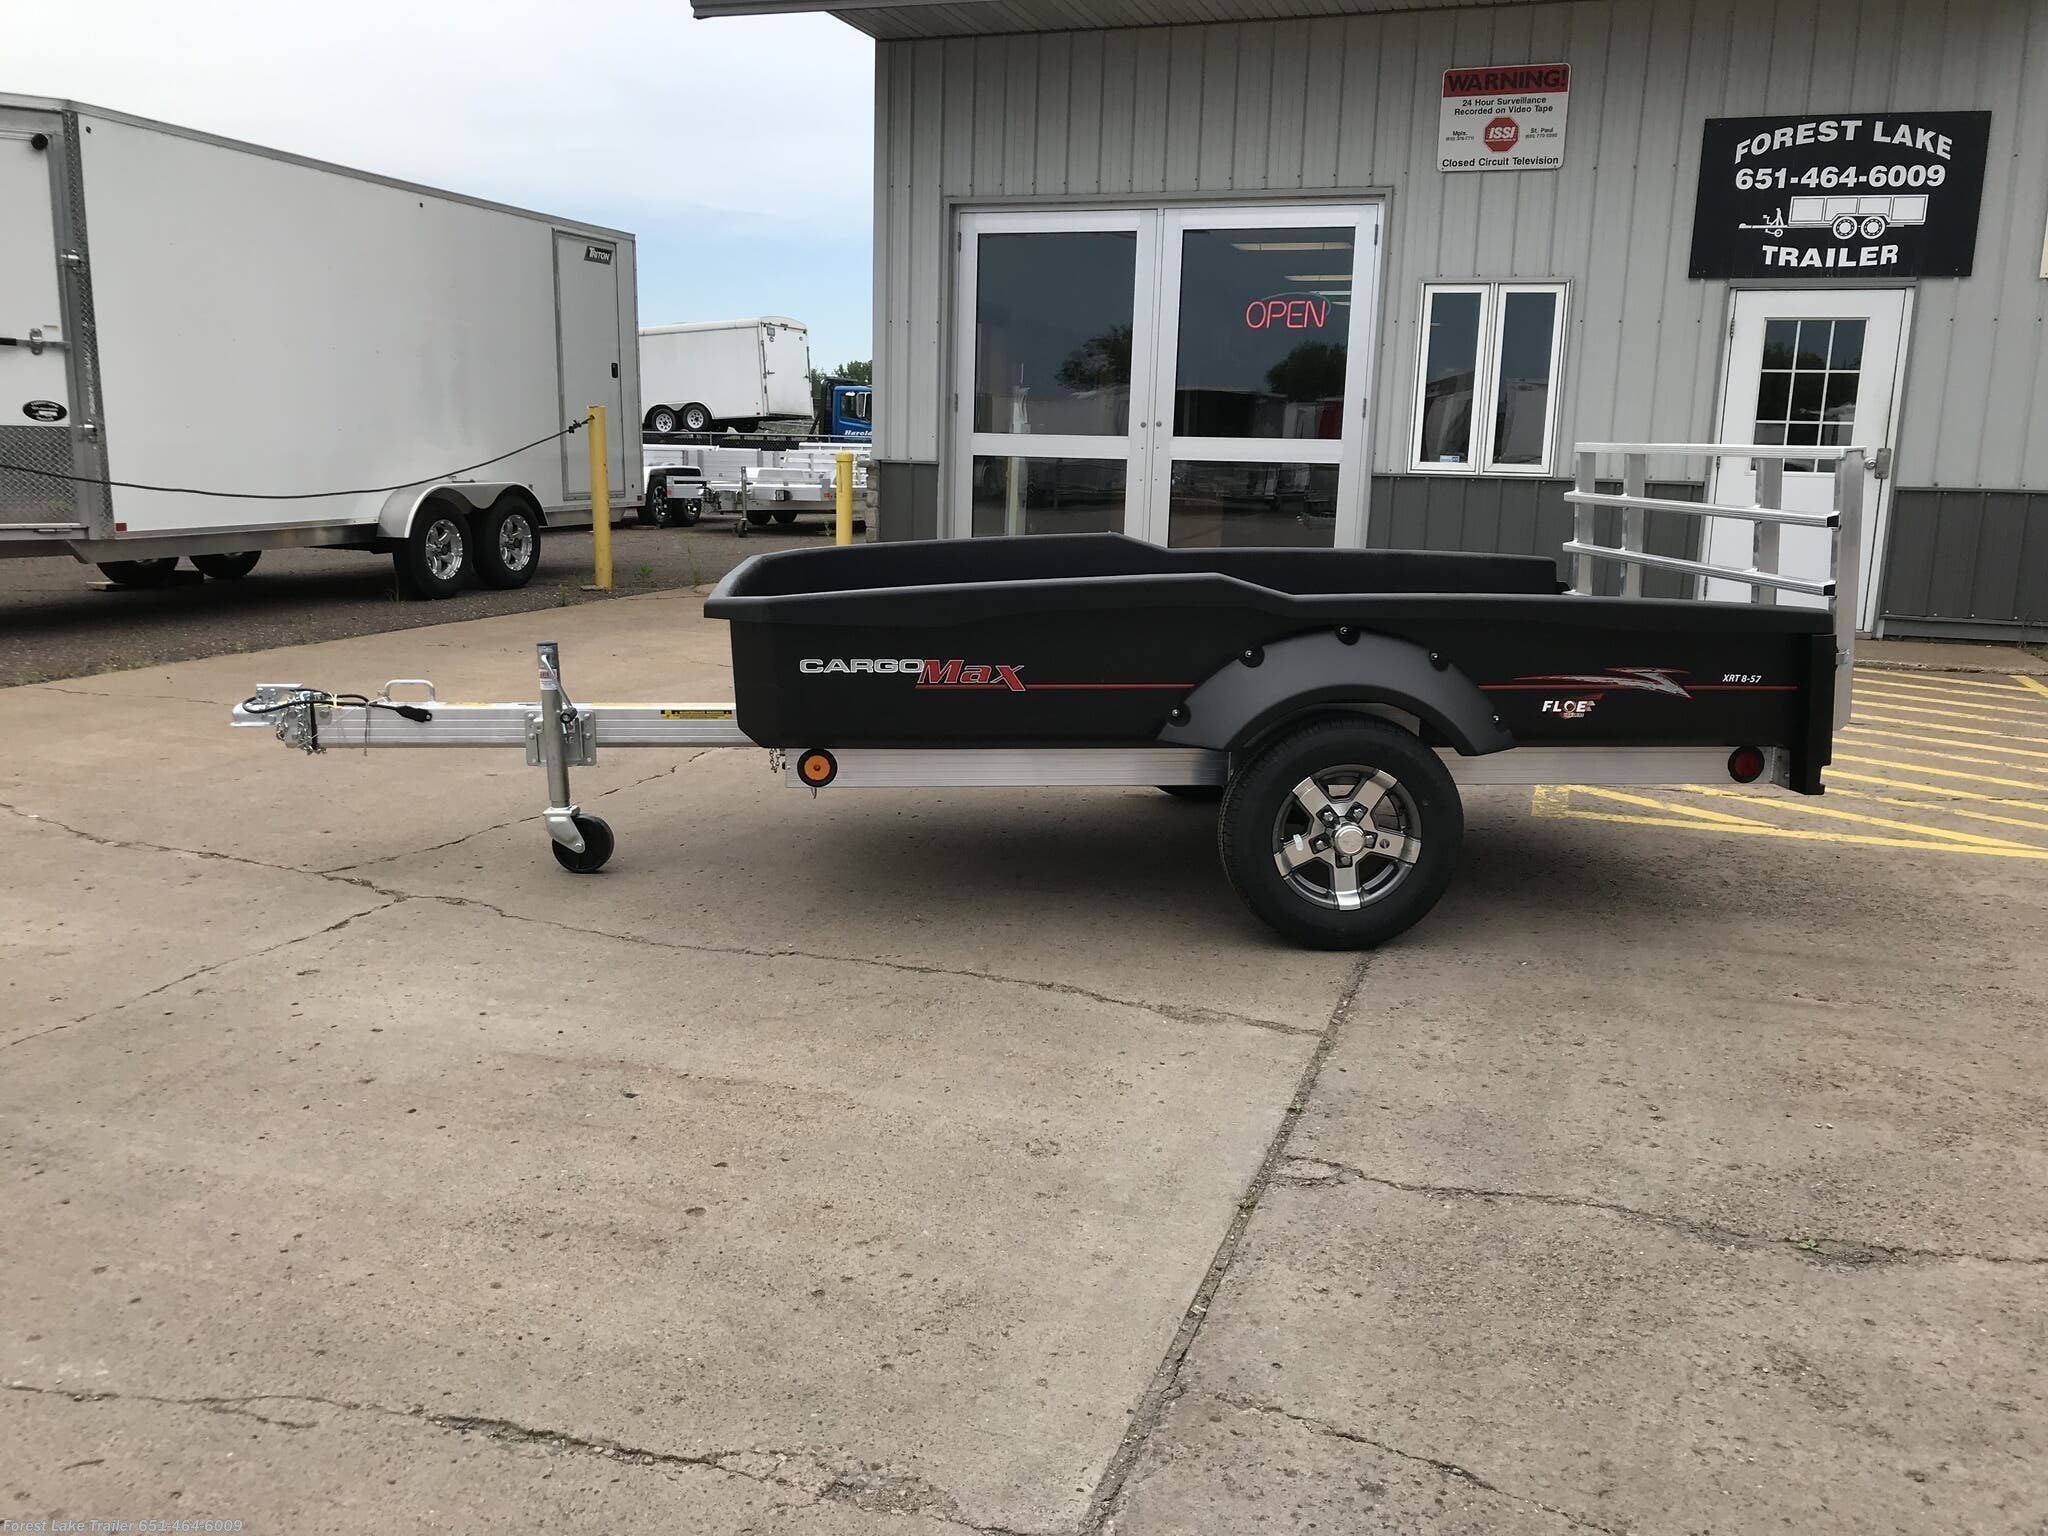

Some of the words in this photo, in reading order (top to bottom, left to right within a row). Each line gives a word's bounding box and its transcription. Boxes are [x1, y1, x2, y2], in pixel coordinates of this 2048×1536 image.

[1448, 70, 1566, 91] WARNING!
[1497, 97, 1547, 105] Surveillance
[1454, 107, 1493, 115] Recorded
[1534, 105, 1553, 113] Tape
[1489, 126, 1516, 139] ISSI
[1734, 119, 1863, 164] FOREST
[1872, 121, 1953, 160] LAKE
[1442, 158, 1475, 167] Closed
[1478, 157, 1509, 166] Circuit
[1512, 156, 1559, 165] Television
[1735, 165, 1946, 190] 651-464-6009
[589, 247, 611, 261] TRITON
[1762, 244, 1899, 268] TRAILER
[1245, 300, 1326, 328] OPEN
[1722, 674, 1741, 683] XRT
[1741, 674, 1762, 683] 8-57
[1542, 700, 1588, 713] FLOE
